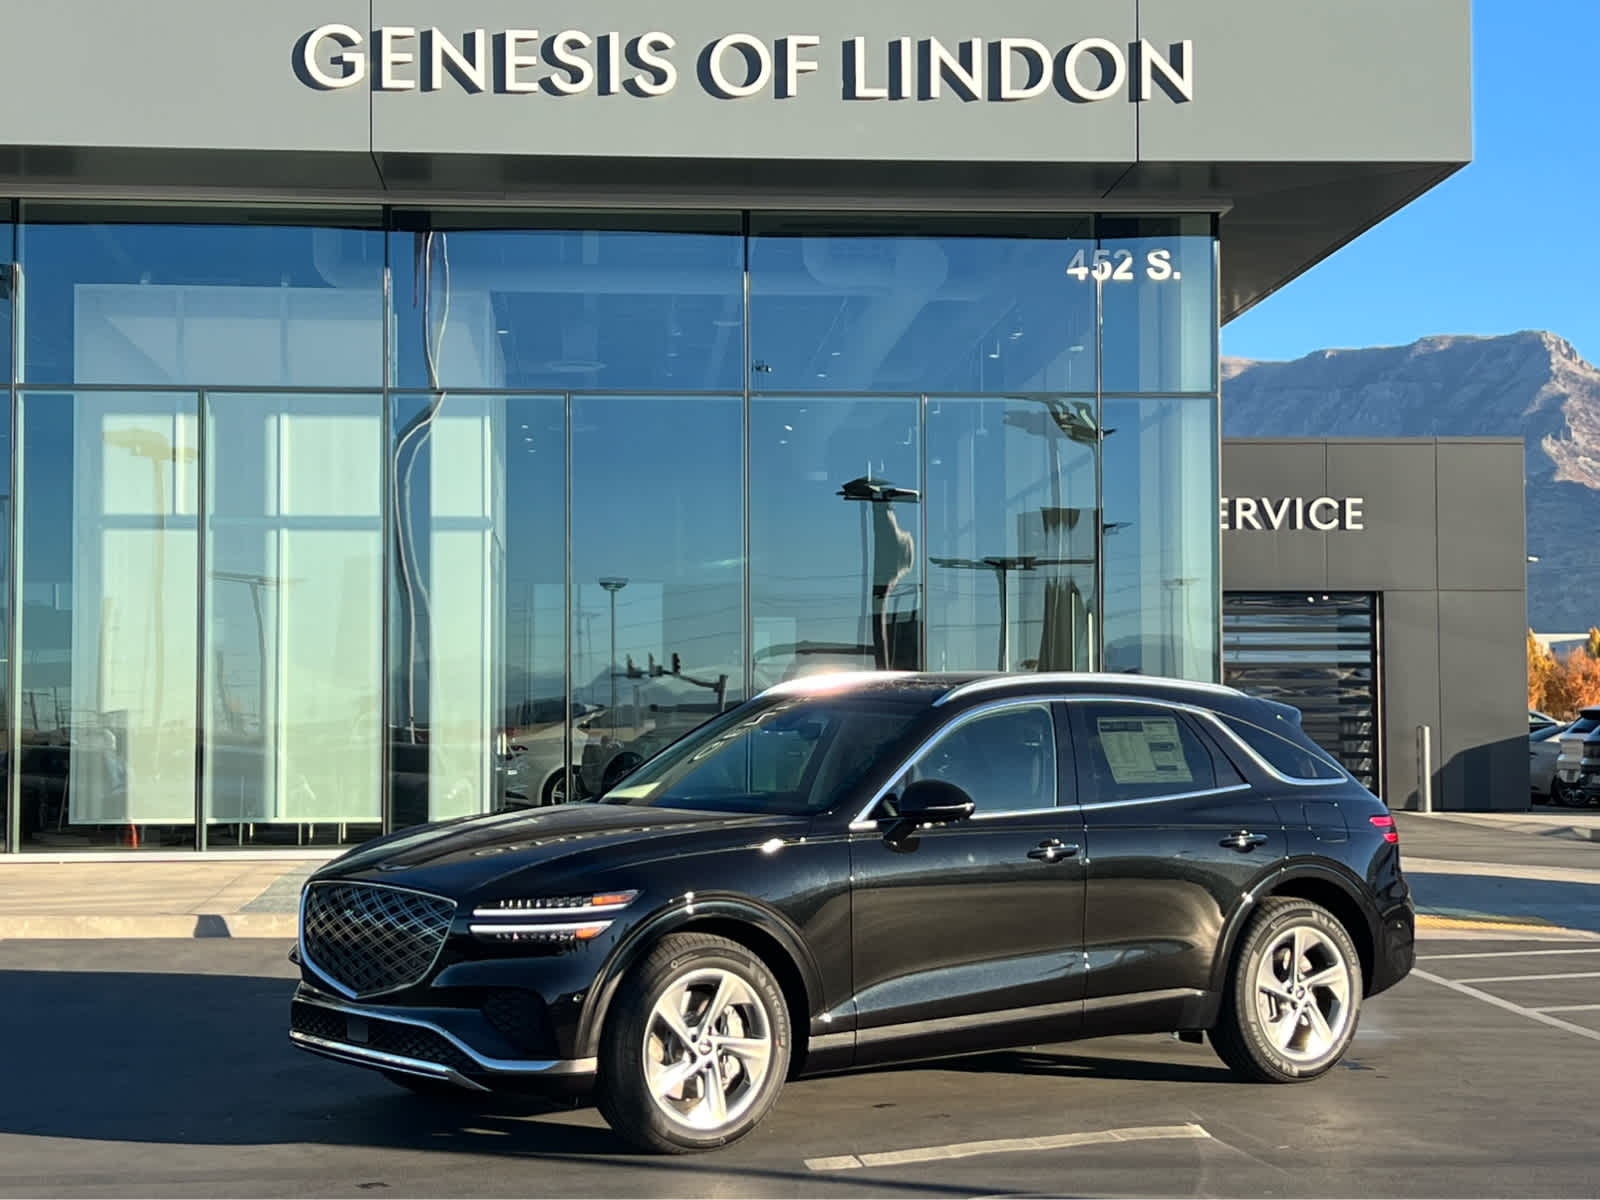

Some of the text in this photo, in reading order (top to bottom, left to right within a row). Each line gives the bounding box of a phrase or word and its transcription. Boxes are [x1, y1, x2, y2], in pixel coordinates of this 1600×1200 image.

[293, 23, 1193, 103] GENESIS OF LINDON
[1065, 248, 1182, 281] 452 S.
